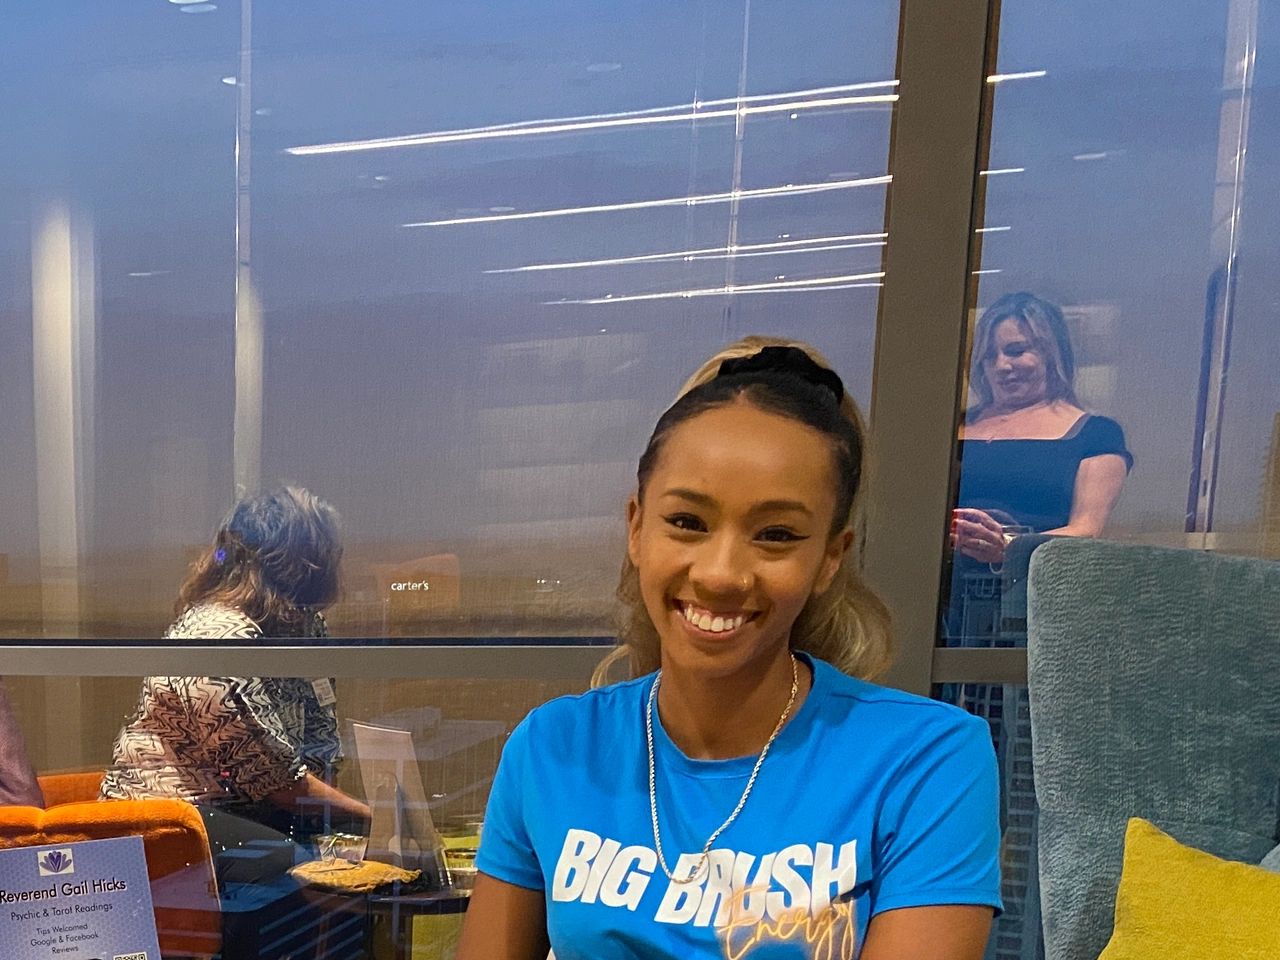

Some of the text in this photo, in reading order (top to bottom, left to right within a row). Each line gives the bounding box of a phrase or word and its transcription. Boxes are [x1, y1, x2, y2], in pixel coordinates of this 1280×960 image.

[391, 580, 428, 591] carter's
[552, 828, 857, 927] BIG BRUSH
[0, 878, 126, 903] Reverend Gail Hicks
[11, 902, 113, 921] Psychic & Tarot Readings
[36, 923, 88, 936] Tips Welcomed
[30, 938, 57, 947] Google
[66, 932, 99, 942] Facebook
[52, 946, 78, 954] Reviews
